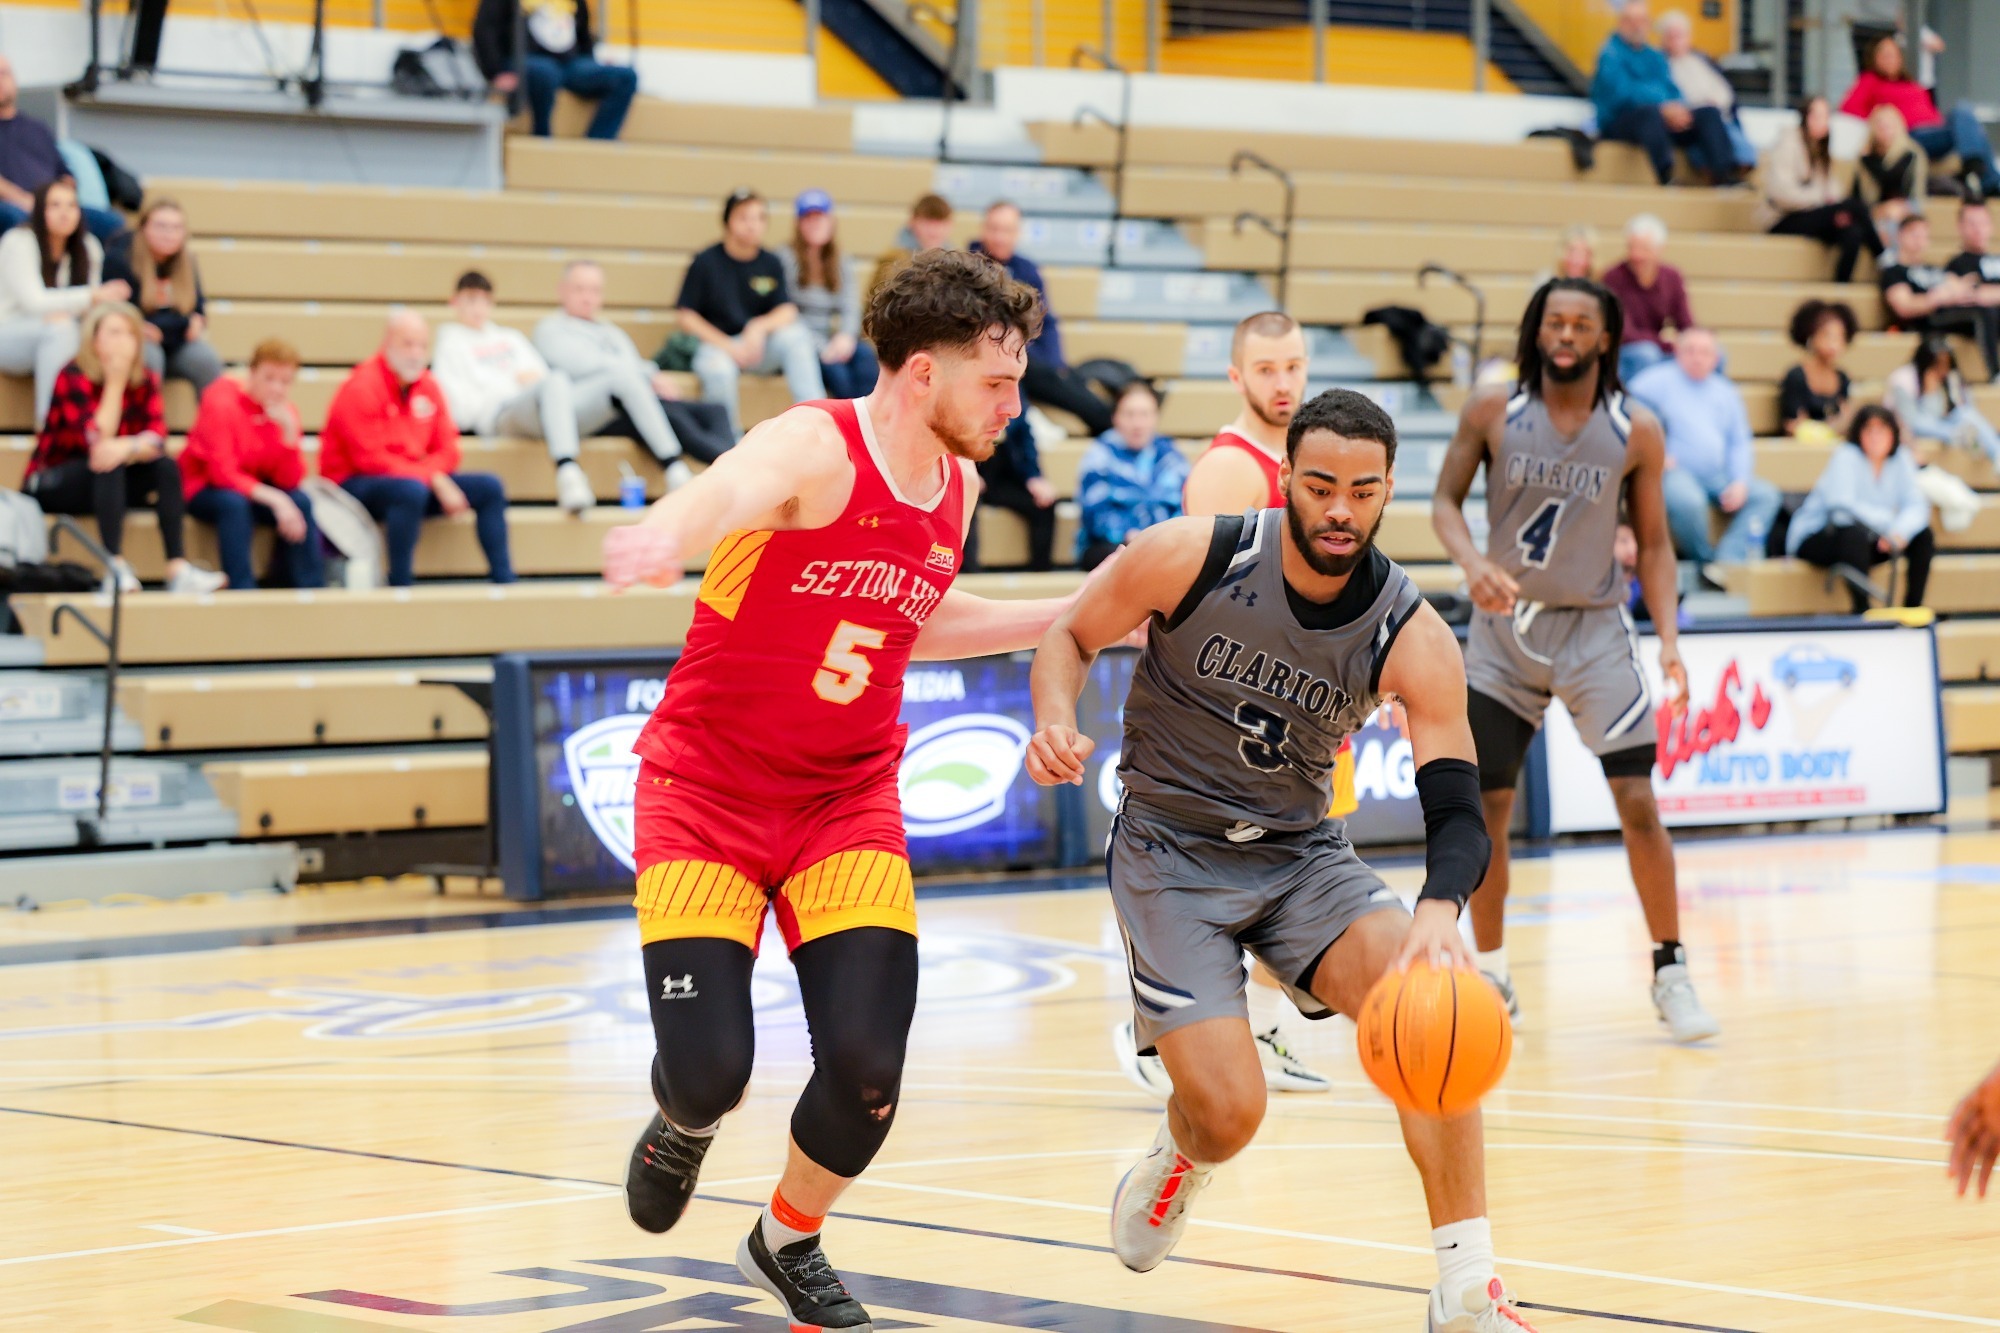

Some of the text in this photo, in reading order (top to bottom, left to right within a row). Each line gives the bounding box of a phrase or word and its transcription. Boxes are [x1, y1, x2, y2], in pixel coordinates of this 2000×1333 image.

[1505, 452, 1612, 503] CLARION
[929, 550, 953, 567] PSAC
[1516, 497, 1567, 570] 4
[791, 560, 906, 604] SETON
[897, 575, 940, 629] HIL
[811, 619, 889, 705] 5
[1195, 633, 1353, 723] CLARION
[1235, 700, 1292, 773] 3
[1698, 749, 1850, 783] AUTO BODY
